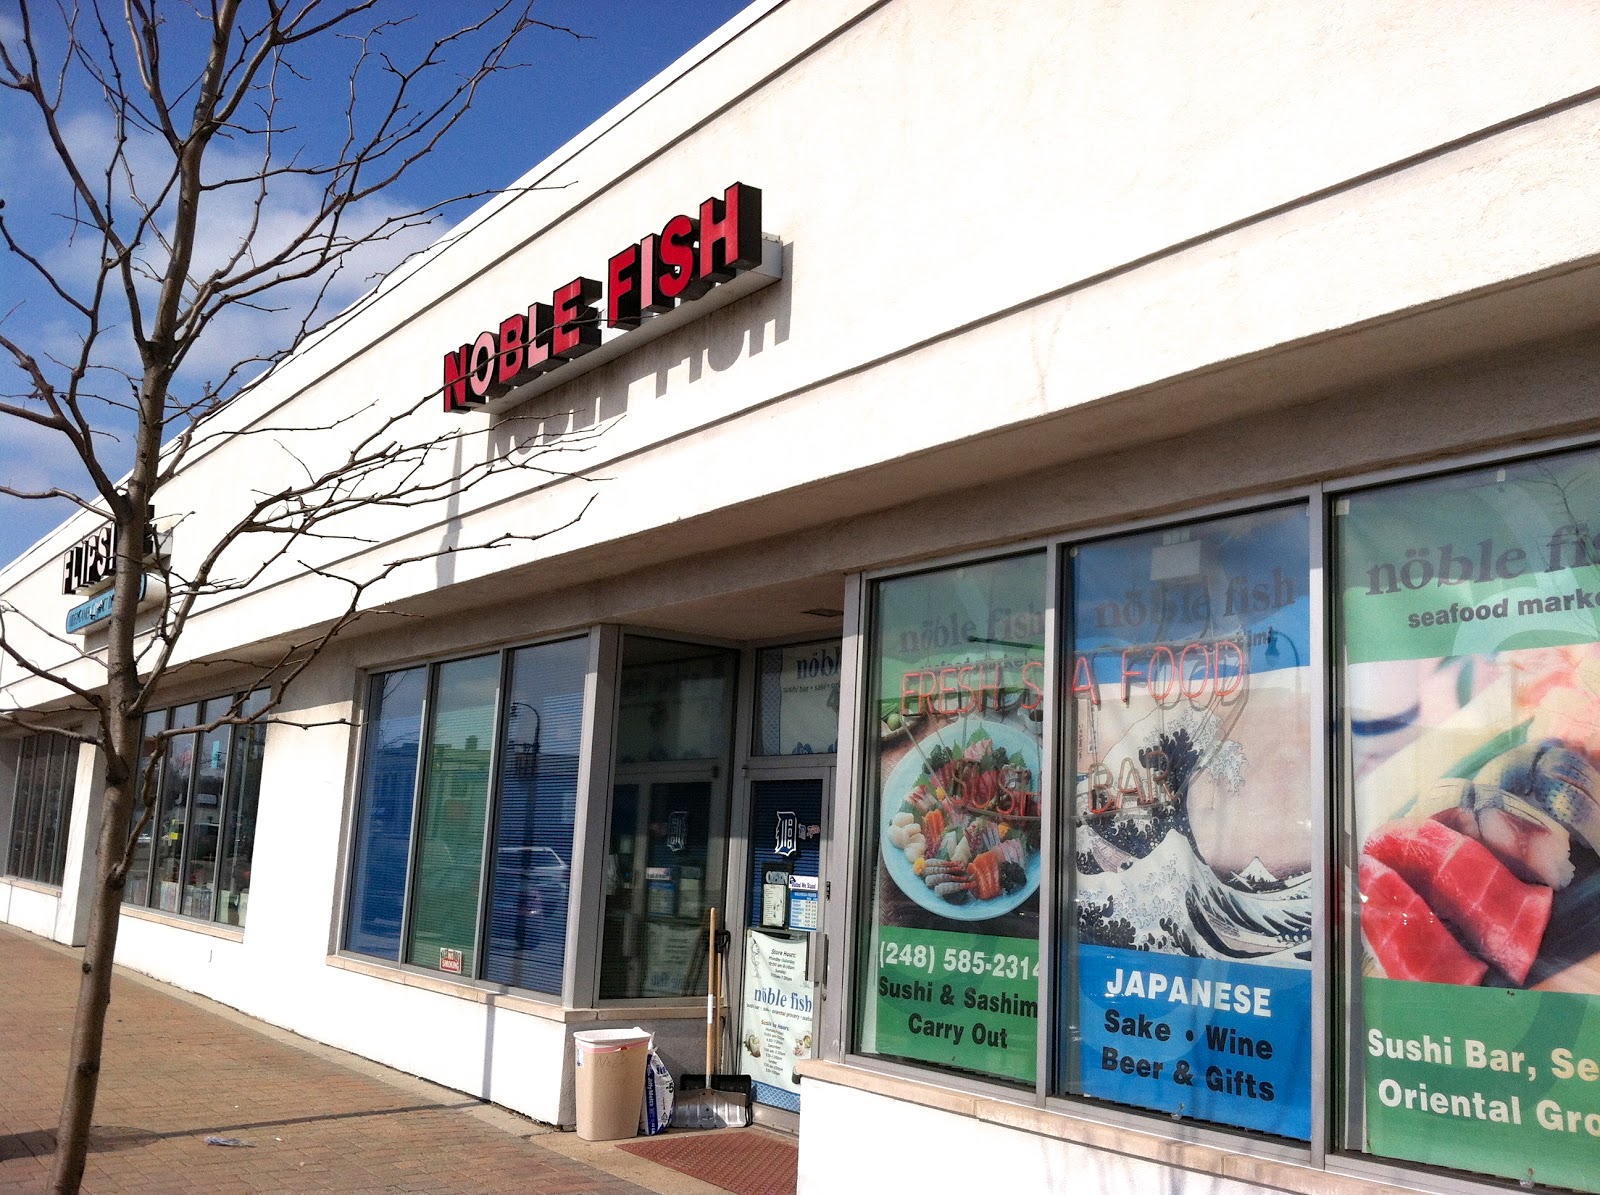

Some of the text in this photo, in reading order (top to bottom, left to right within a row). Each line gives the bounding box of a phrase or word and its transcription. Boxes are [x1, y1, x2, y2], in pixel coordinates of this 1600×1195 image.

[444, 182, 762, 413] NOBLE FISH
[1365, 538, 1527, 596] nöble
[1095, 567, 1296, 628] nöble fish
[1408, 598, 1508, 629] seafood
[899, 611, 976, 653] nöble
[901, 664, 1001, 716] FRESH
[1120, 641, 1245, 703] FOOD
[1088, 750, 1179, 815] BAR
[879, 940, 935, 974] (248)
[754, 987, 813, 1013] nöble fish
[879, 976, 932, 1003] Sushi
[939, 984, 955, 1005] &
[1106, 968, 1272, 1018] JAPANESE
[908, 1013, 1008, 1049] Carry Out
[1104, 1009, 1273, 1060] Sake Wine
[1368, 1028, 1451, 1065] Sushi
[1465, 1040, 1536, 1082] Bar,
[1101, 1046, 1275, 1101] Beer & Gifts
[1378, 1078, 1521, 1125] Oriental
